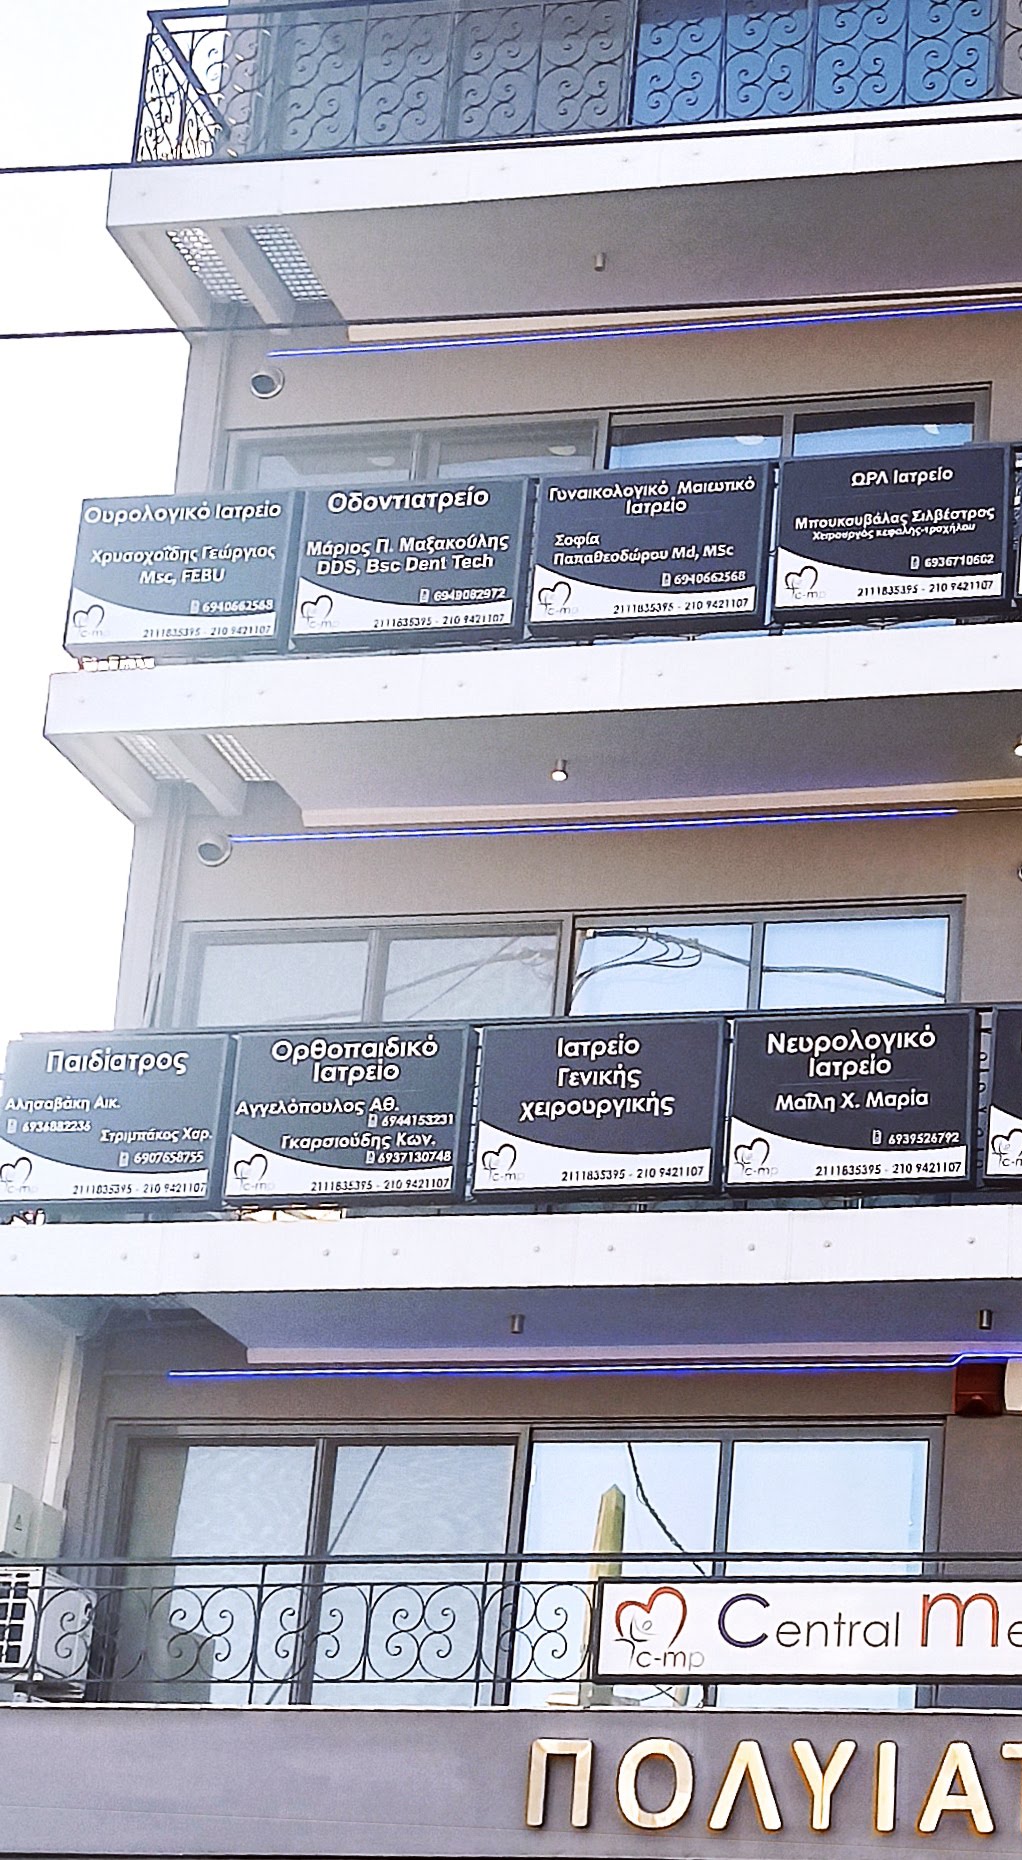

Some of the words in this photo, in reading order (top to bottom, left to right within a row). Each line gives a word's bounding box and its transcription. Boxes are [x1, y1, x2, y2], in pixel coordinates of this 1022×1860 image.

[852, 470, 889, 487] ΩΡΛ
[894, 466, 954, 485] Ιατρείο
[328, 486, 489, 513] Οδοντιατρείο
[549, 480, 669, 502] Γυναικολογικό
[677, 477, 756, 495] Μαιευτικό
[84, 502, 210, 526] Ουρολογικό
[215, 500, 282, 522] Ιατρείο
[626, 498, 687, 516] Ιατρείο
[795, 512, 908, 530] Μπουκουβάλας
[912, 507, 995, 524] Σιλβέστρος
[555, 532, 600, 548] Σοφία
[812, 528, 875, 541] Χειρουργός
[201, 544, 276, 562] Γεώργιος
[306, 541, 371, 558] Μάριος
[399, 534, 509, 553] Μαξακούλης
[553, 549, 669, 566] Παπαθεοδώρου
[672, 546, 699, 560] Md,
[703, 545, 734, 557] MSc
[181, 569, 225, 583] FEBU
[317, 560, 361, 577] DDS,
[366, 559, 400, 574] Bsc
[405, 556, 447, 572] Dent
[453, 554, 493, 569] Tech
[857, 585, 918, 596] 2111835395
[951, 581, 993, 591] 9421107
[613, 603, 674, 614] 2111835395
[706, 599, 748, 609] 9421107
[143, 628, 200, 638] 2111835395
[231, 625, 271, 635] 9421107
[374, 618, 431, 628] 2111835395
[464, 614, 504, 624] 9421107
[271, 1034, 438, 1065] Ορθοπαιδικό
[557, 1033, 640, 1061] Ιατρείο
[767, 1024, 936, 1057] Νευρολογικό
[47, 1048, 189, 1076] Παιδίατρος
[313, 1059, 400, 1085] Ιατρείο
[809, 1053, 891, 1080] Ιατρείο
[557, 1064, 642, 1088] Γενικής
[94, 1096, 120, 1109] Αικ.
[235, 1098, 365, 1117] Αγγελόπουλος
[369, 1097, 399, 1112] Αθ.
[519, 1091, 676, 1122] χειρουργικής
[775, 1092, 836, 1113] Μαΐλη
[841, 1092, 860, 1109] Χ.
[866, 1088, 929, 1110] Μαρία
[100, 1129, 180, 1144] Στριμπάκος
[182, 1127, 213, 1142] Χαρ.
[281, 1132, 391, 1152] Γκαρσιούδης
[396, 1133, 436, 1147] Κων.
[561, 1170, 625, 1182] 2111835395
[637, 1169, 657, 1178] 210
[659, 1166, 704, 1177] 9421107
[815, 1165, 882, 1176] 2111835395
[892, 1164, 912, 1174] 210
[916, 1162, 961, 1172] 9421107
[164, 1183, 206, 1192] 9421107
[311, 1180, 373, 1191] 2111835395
[384, 1180, 402, 1189] 210
[405, 1178, 449, 1188] 9421107
[718, 1592, 900, 1649] Central
